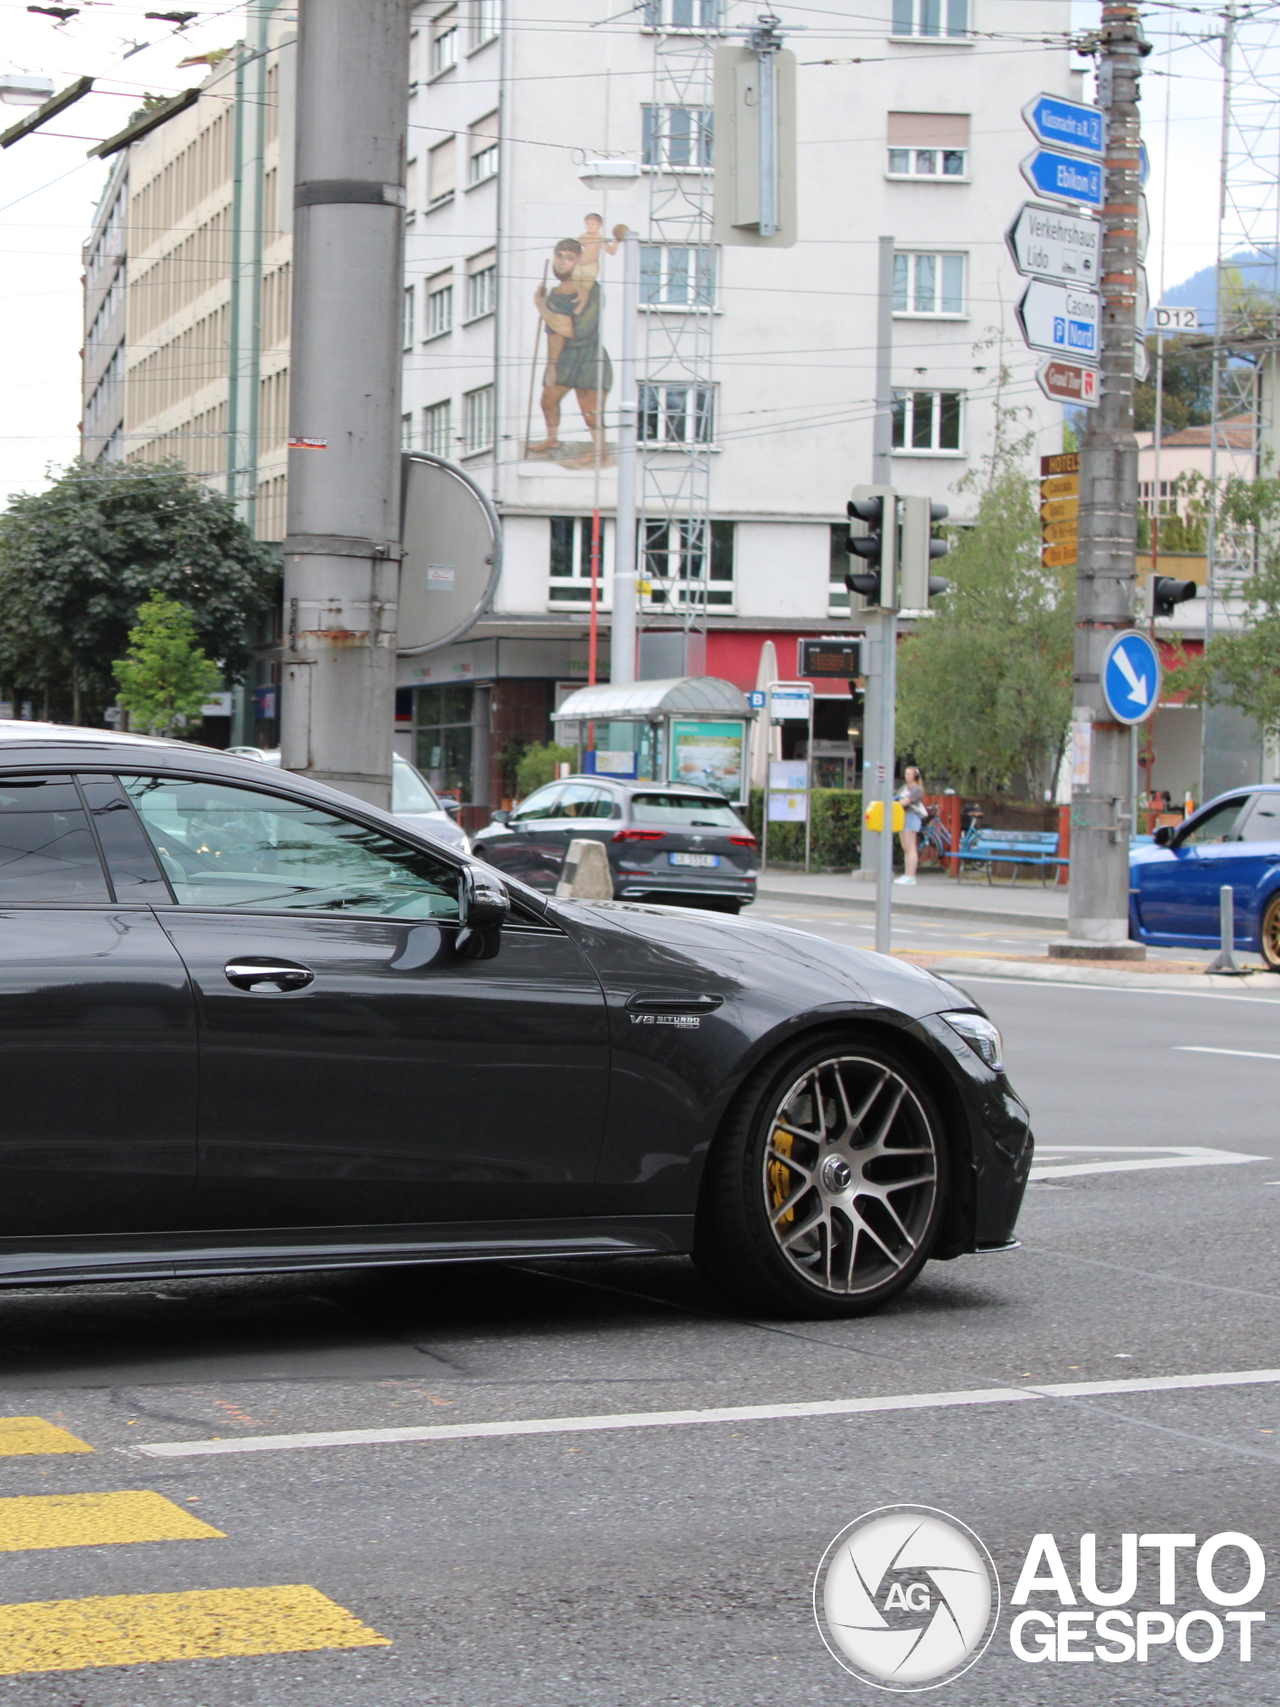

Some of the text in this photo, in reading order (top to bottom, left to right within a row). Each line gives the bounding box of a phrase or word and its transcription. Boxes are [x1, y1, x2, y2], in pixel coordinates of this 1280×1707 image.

[1057, 165, 1089, 193] Ebikon
[1029, 214, 1096, 249] Verkehrshaus
[1027, 245, 1049, 269] Lido
[1066, 293, 1095, 319] Casino
[1156, 309, 1195, 328] D12
[1070, 323, 1094, 348] Nord
[754, 694, 763, 705] B
[629, 1014, 700, 1025] V8 BITURBO
